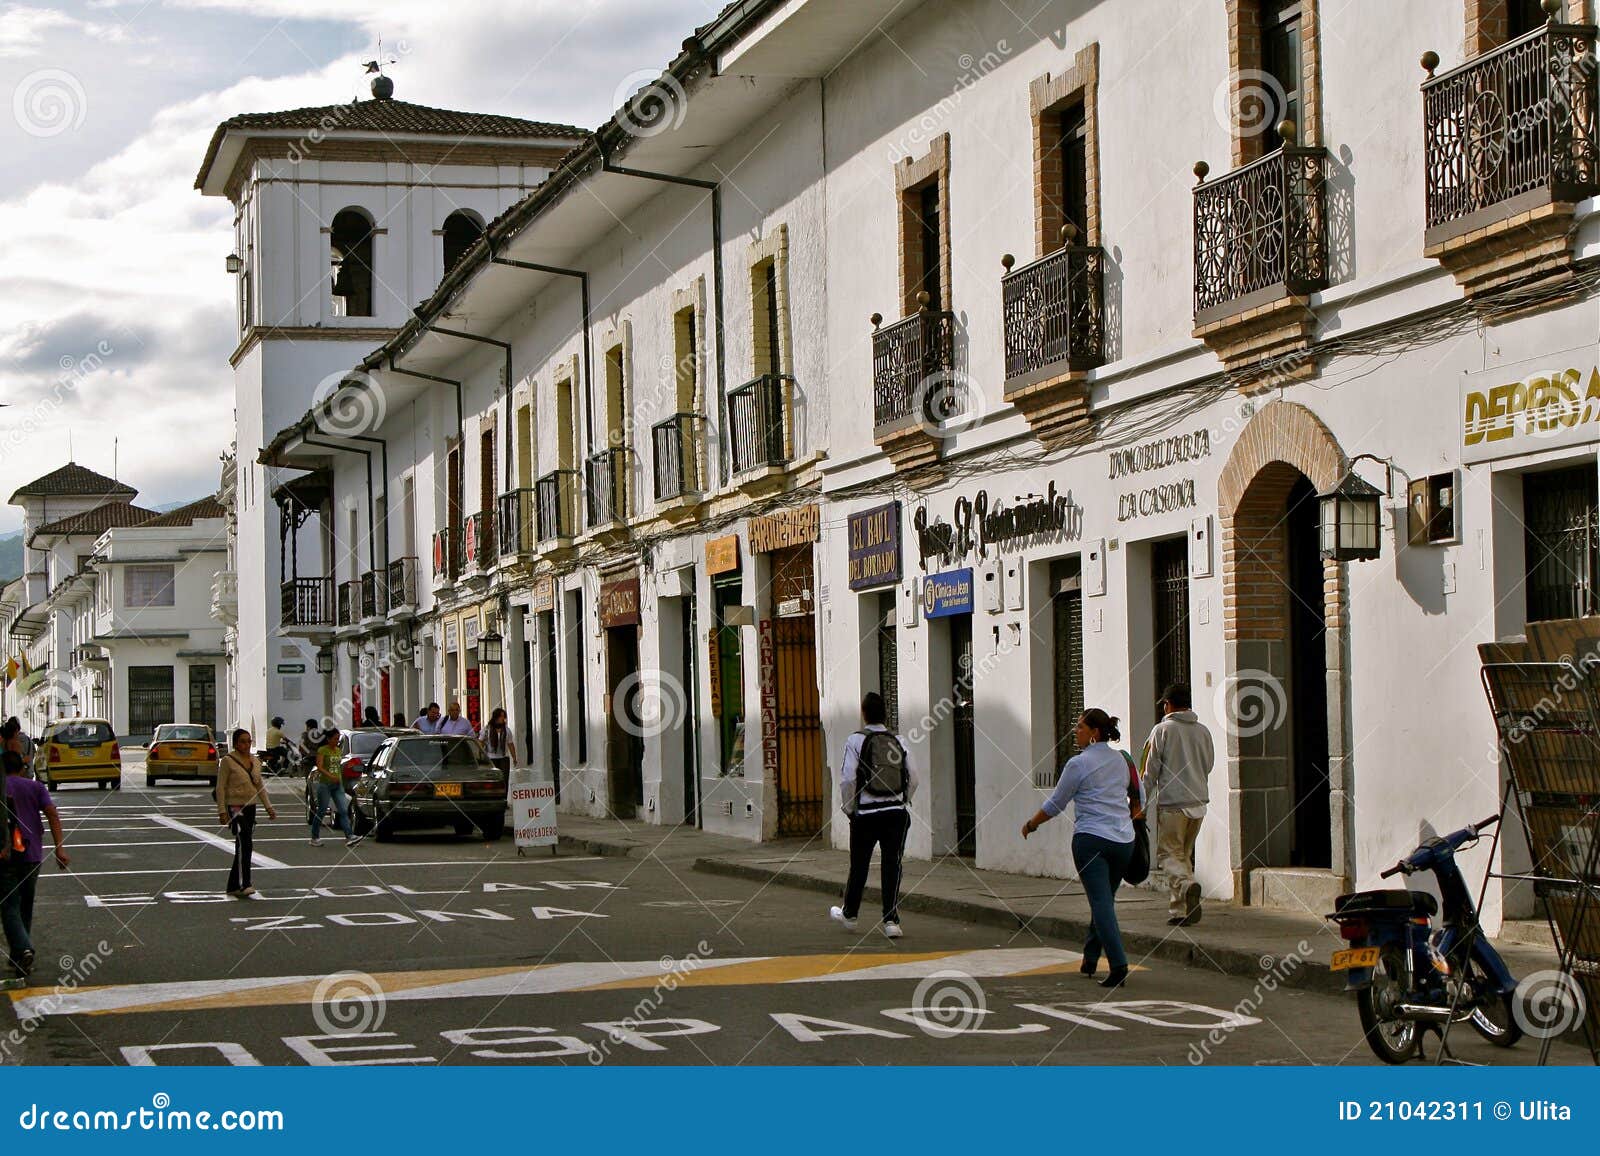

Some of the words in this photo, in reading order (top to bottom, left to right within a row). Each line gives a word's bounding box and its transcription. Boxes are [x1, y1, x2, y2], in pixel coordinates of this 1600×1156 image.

[1117, 492, 1138, 522] LA
[1139, 477, 1197, 517] CASONA
[747, 503, 820, 557] PARQUEADERO
[853, 518, 865, 551] EL
[867, 510, 892, 547] BAUL
[849, 558, 862, 581] DEL
[863, 550, 896, 578] BORDADO
[512, 786, 555, 800] SERVICIO
[528, 807, 541, 818] DE
[515, 825, 558, 840] PARQUEADERO
[84, 880, 630, 908] ESCOLAR
[229, 906, 611, 931] ZONA
